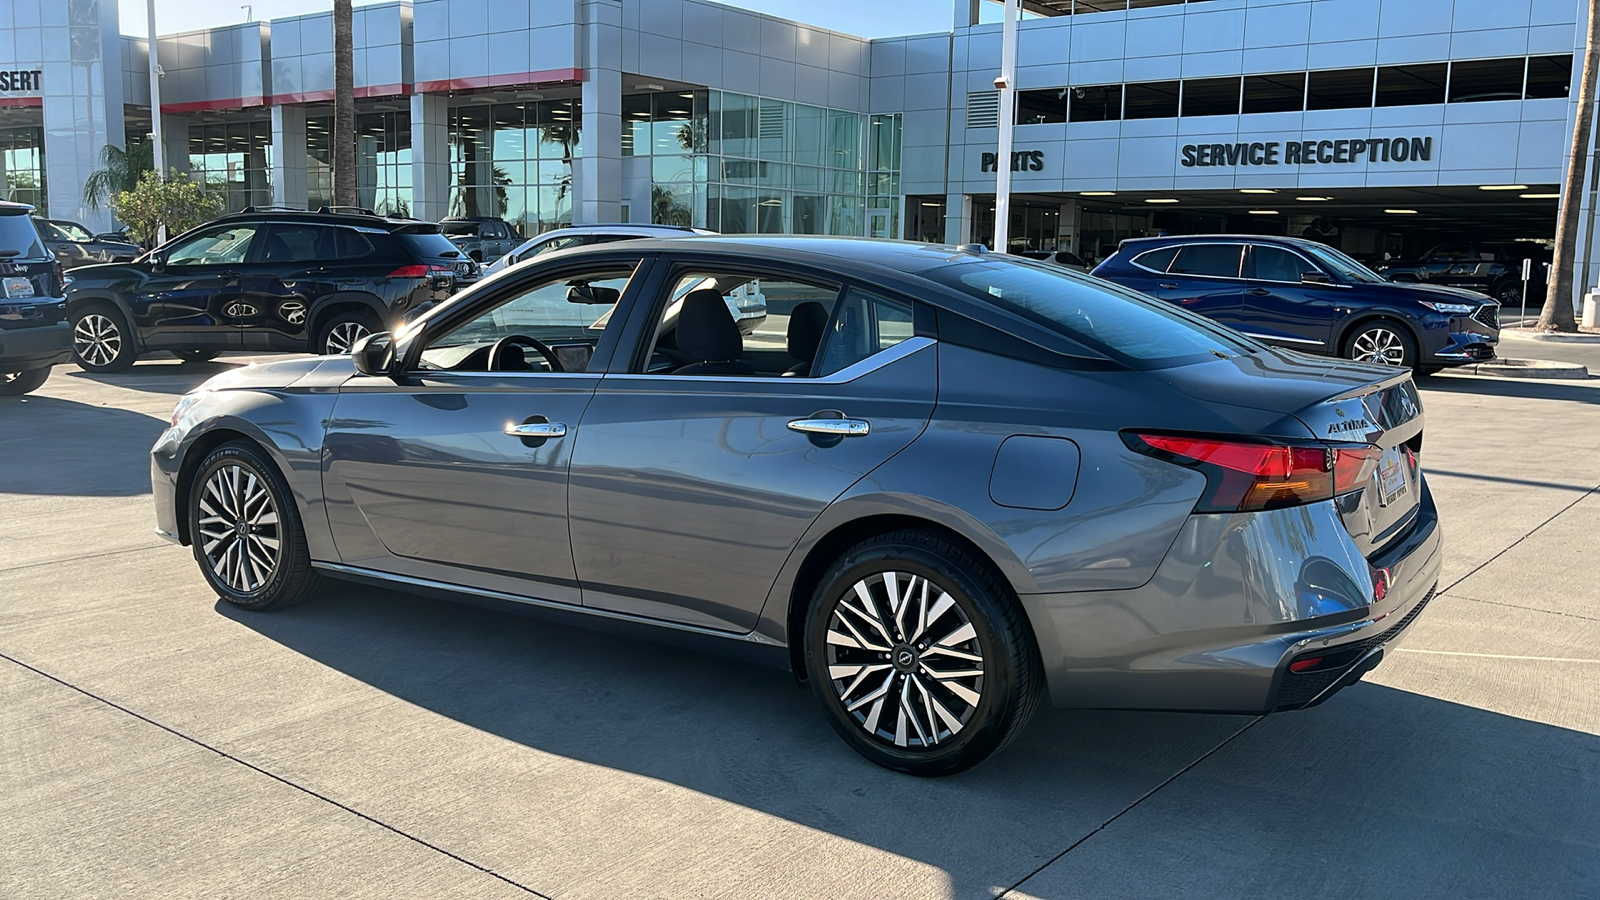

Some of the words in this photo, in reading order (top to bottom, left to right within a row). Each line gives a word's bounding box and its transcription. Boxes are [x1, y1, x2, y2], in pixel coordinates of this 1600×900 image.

[0, 70, 42, 91] SERT
[1181, 141, 1280, 167] SERVICE
[1284, 136, 1433, 165] RECEPTION
[1328, 419, 1369, 434] ALTIMA
